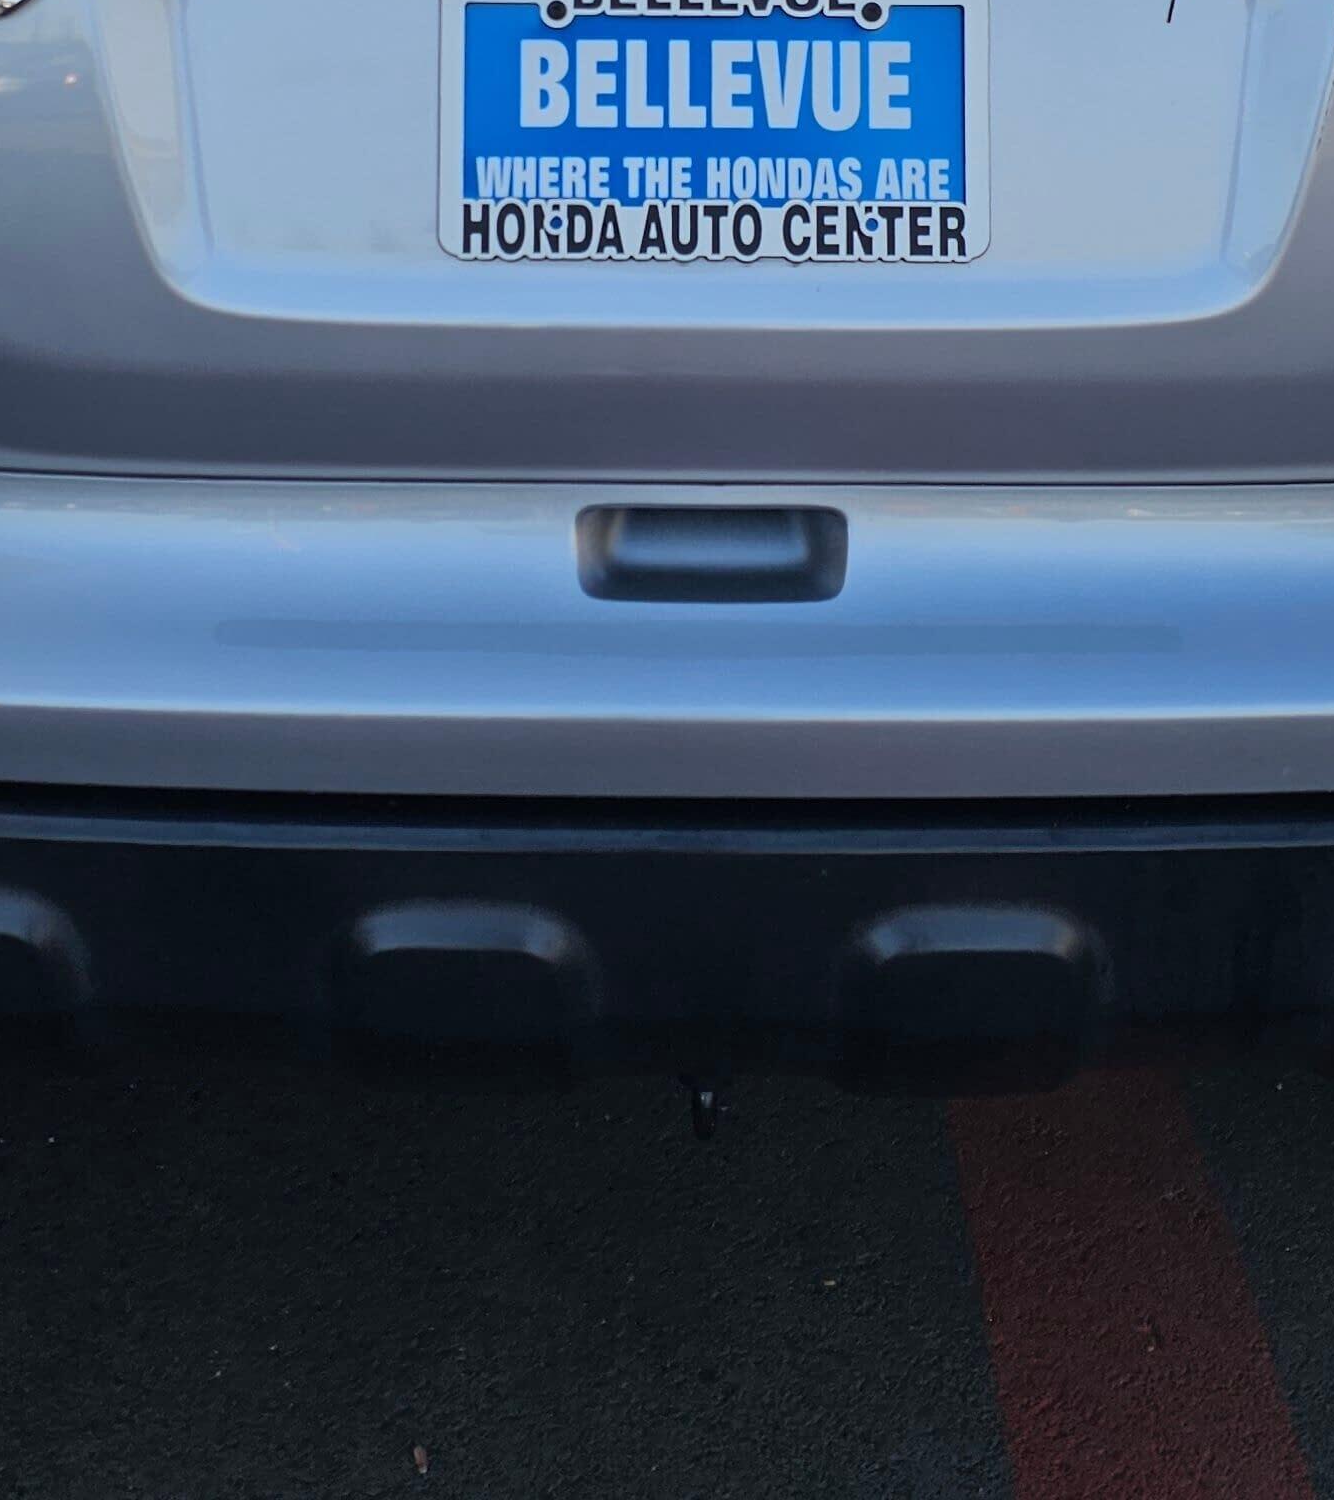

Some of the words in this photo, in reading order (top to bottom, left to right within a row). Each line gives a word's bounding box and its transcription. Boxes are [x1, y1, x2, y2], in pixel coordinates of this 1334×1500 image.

[518, 38, 913, 132] BELLEVUE
[475, 155, 611, 199] WHERE
[623, 156, 693, 199] THE
[705, 157, 863, 201] HONDAS
[875, 158, 951, 201] ARE
[462, 202, 624, 256] HONDA
[638, 202, 763, 256] AUTO
[781, 202, 966, 257] CENTER
